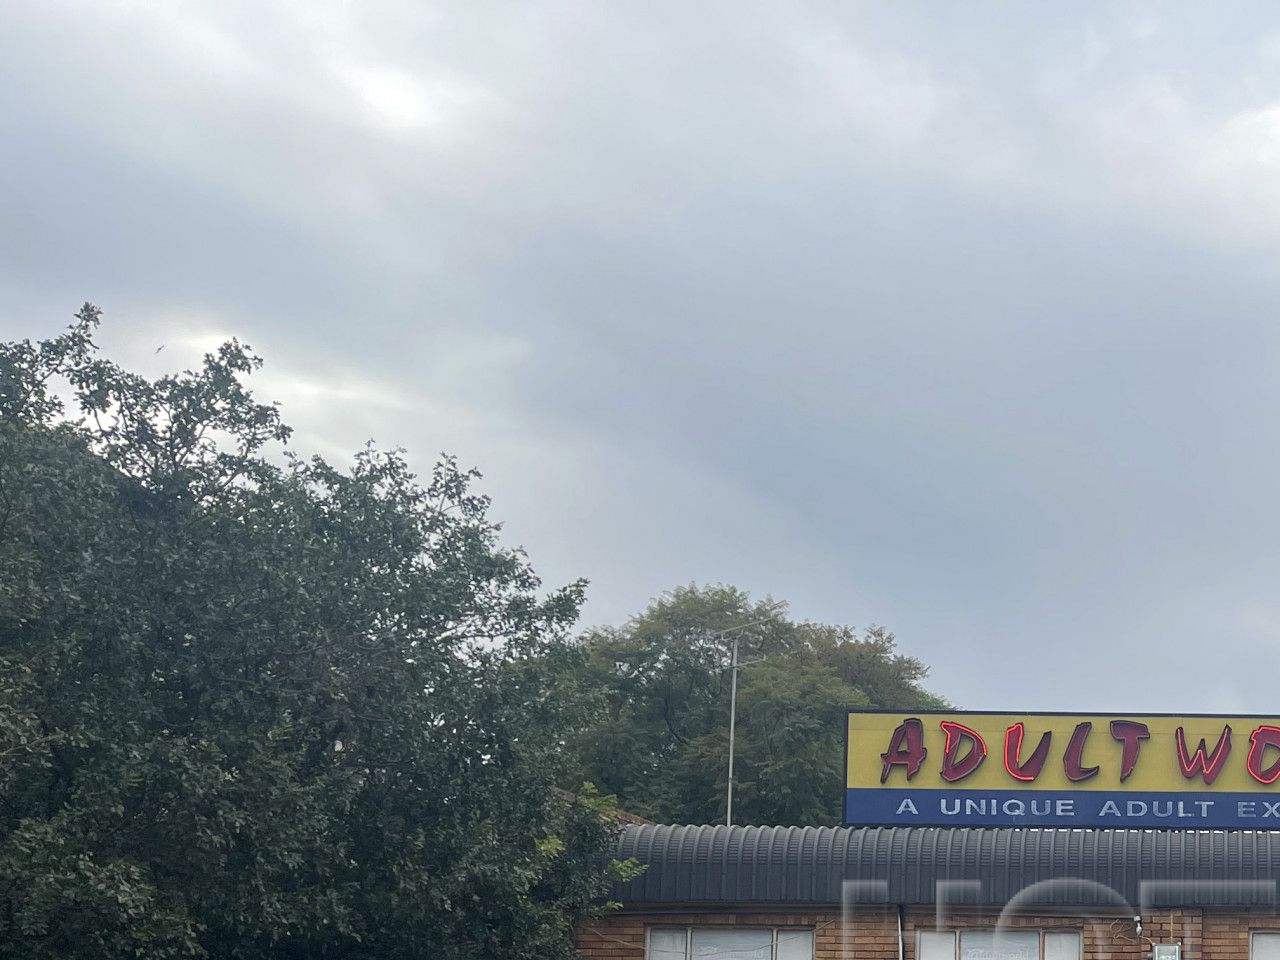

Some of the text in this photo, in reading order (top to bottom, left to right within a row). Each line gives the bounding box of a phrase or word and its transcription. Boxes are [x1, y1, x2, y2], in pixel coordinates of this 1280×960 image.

[880, 717, 1151, 784] ADULT
[895, 798, 919, 816] A
[940, 798, 1075, 817] UNIQUE
[1098, 799, 1215, 818] ADULT
